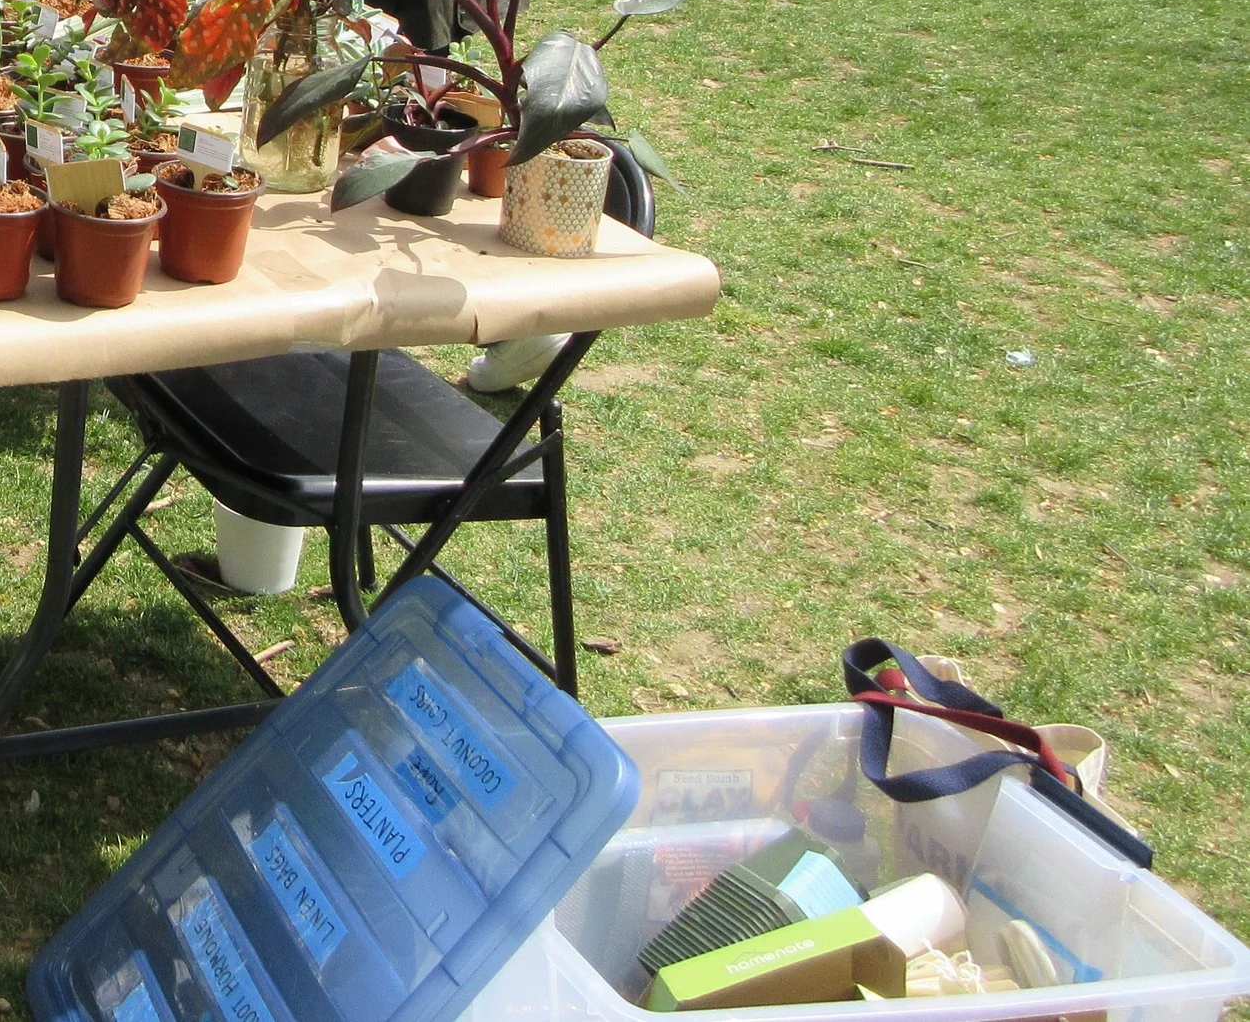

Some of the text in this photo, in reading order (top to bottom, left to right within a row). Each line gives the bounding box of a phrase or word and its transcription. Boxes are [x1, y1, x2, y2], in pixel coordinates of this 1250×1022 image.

[410, 684, 501, 794] COCONUT COIRS
[345, 780, 411, 865] PLANTERS
[264, 845, 335, 944] LINEN BAGS
[193, 918, 240, 997] HORMONE
